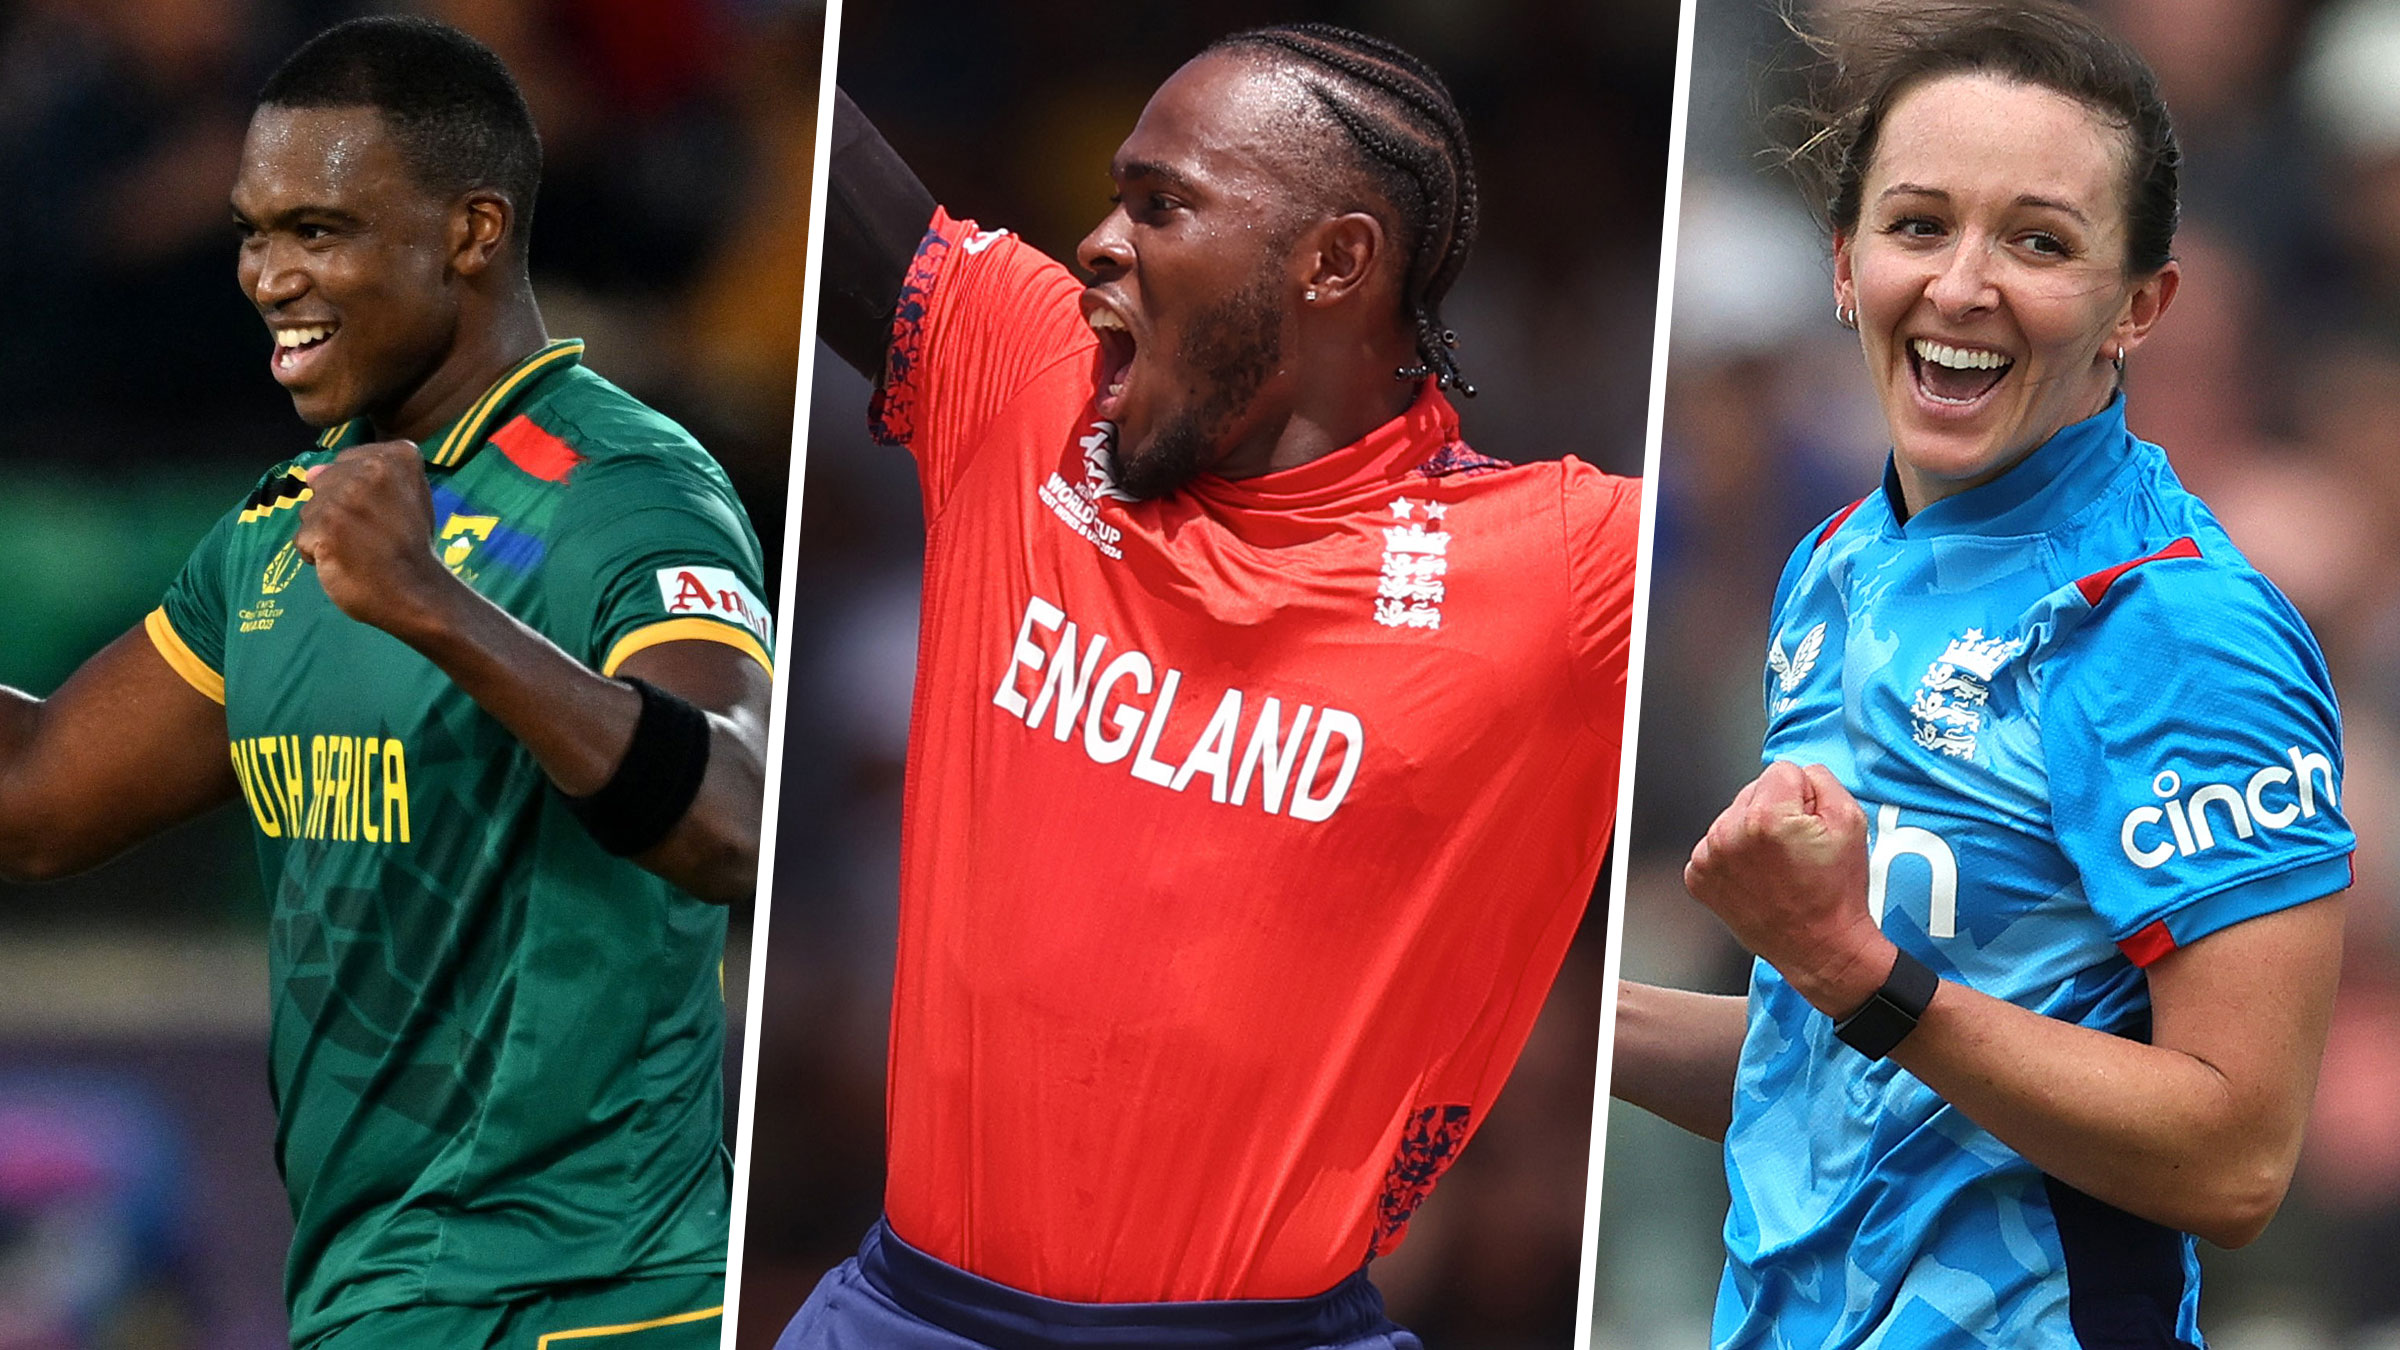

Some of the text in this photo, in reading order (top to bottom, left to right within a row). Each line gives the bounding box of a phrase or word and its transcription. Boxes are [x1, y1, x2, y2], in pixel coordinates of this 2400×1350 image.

[1046, 471, 1094, 525] WORLD
[1094, 517, 1122, 544] CUP
[993, 596, 1364, 822] ENGLAND
[231, 735, 411, 843] OUTH AFRICA
[2121, 746, 2337, 869] cinch
